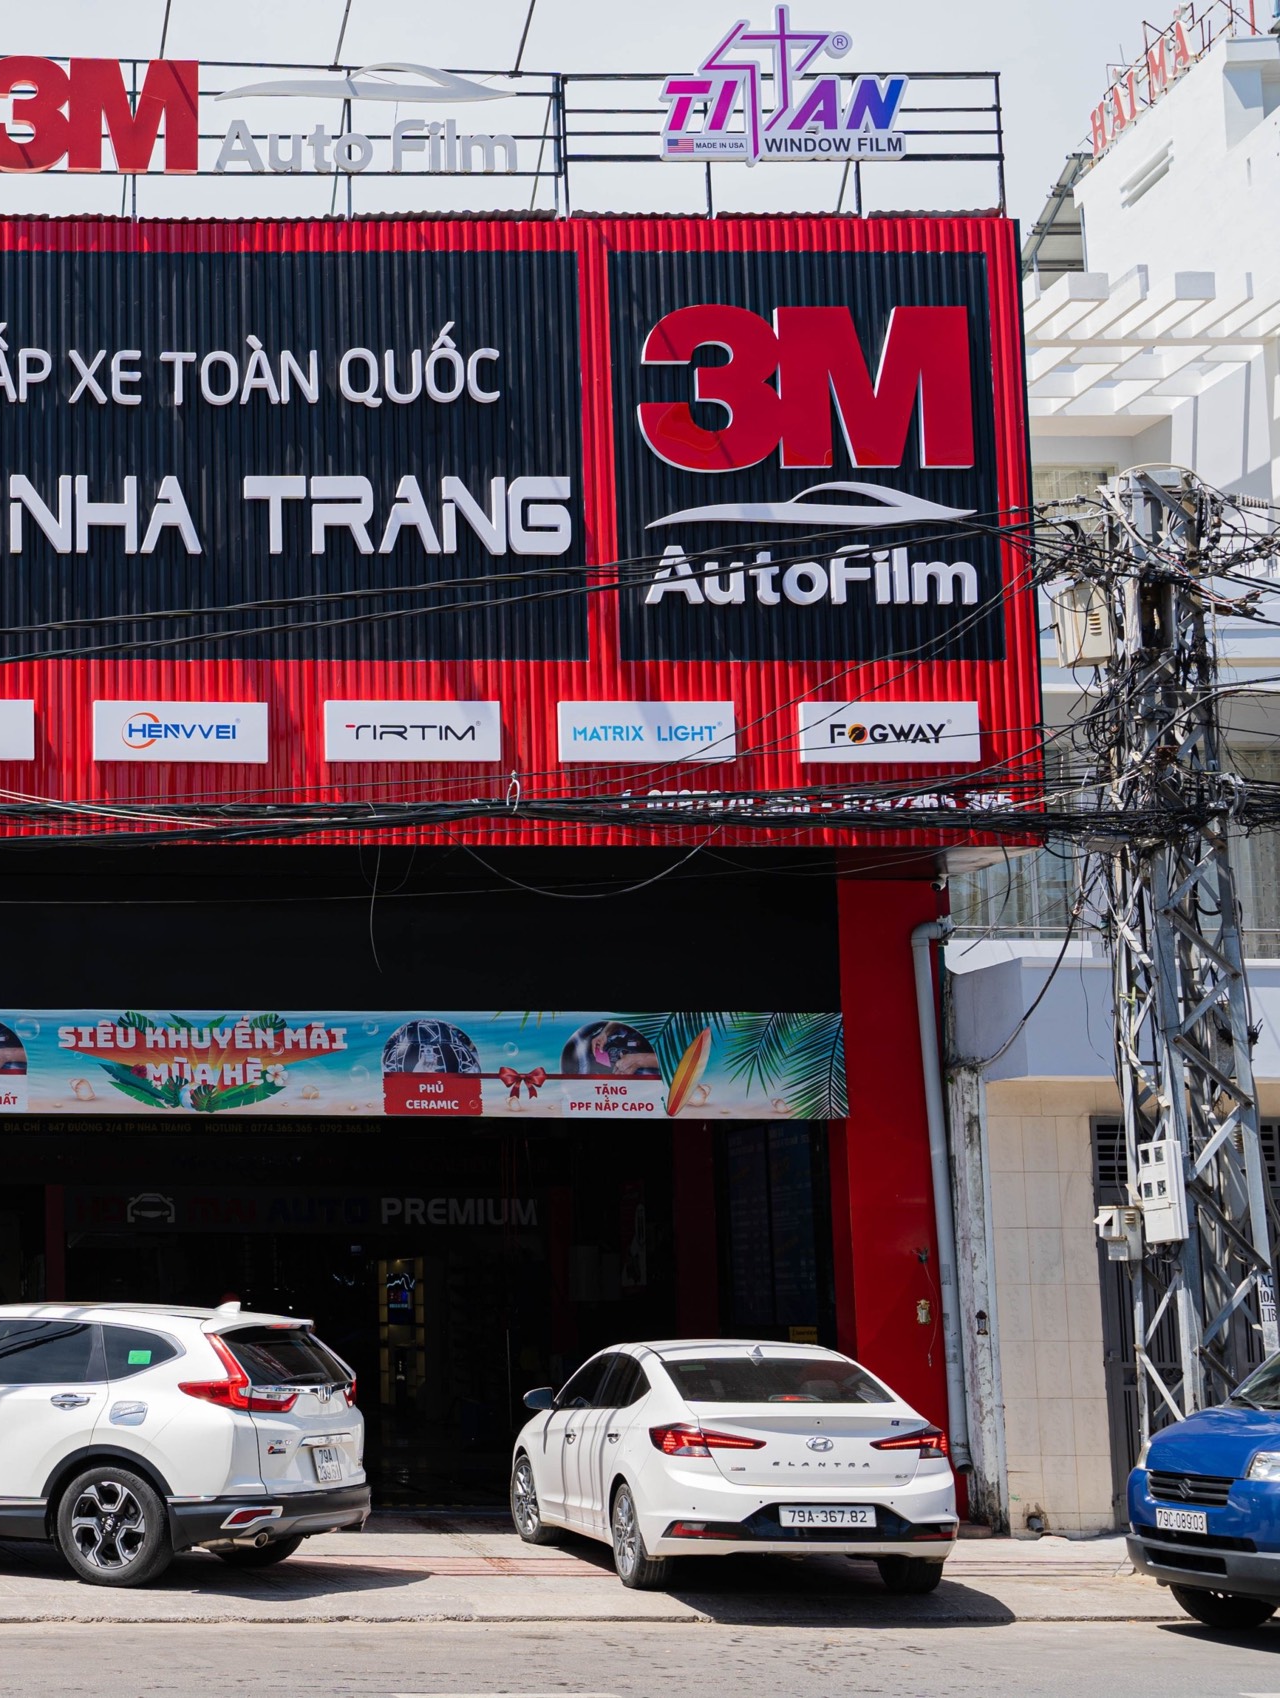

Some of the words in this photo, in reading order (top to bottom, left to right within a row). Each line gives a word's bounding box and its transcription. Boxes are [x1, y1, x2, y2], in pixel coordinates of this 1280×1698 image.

[214, 118, 374, 174] Auto
[391, 118, 518, 174] Film
[764, 138, 855, 153] WINDOW
[857, 137, 902, 152] FILM
[68, 349, 143, 406] XE
[159, 334, 320, 406] TOÀN
[338, 321, 501, 408] QUỐC
[636, 303, 975, 474] 3M
[9, 474, 203, 555] NHA
[243, 474, 572, 556] TRANG
[644, 544, 979, 606] AutoFilm
[345, 723, 476, 741] TIRTIM
[572, 725, 645, 742] MATRIX
[656, 725, 718, 742] LIGHT
[829, 722, 948, 744] FOGWAY
[57, 1020, 137, 1049] SIÊU
[145, 1015, 278, 1049] KHUYẾN
[283, 1022, 349, 1050] MÃI
[145, 1057, 219, 1086] MÙA
[222, 1057, 264, 1086] HÈ
[418, 1081, 445, 1094] PHỦ
[594, 1085, 628, 1099] TẶNG
[405, 1099, 460, 1111] CERAMIC
[569, 1102, 590, 1111] PPF
[622, 1102, 655, 1112] CAPO
[380, 1196, 539, 1227] PREMIUM
[318, 1449, 334, 1463] 79A
